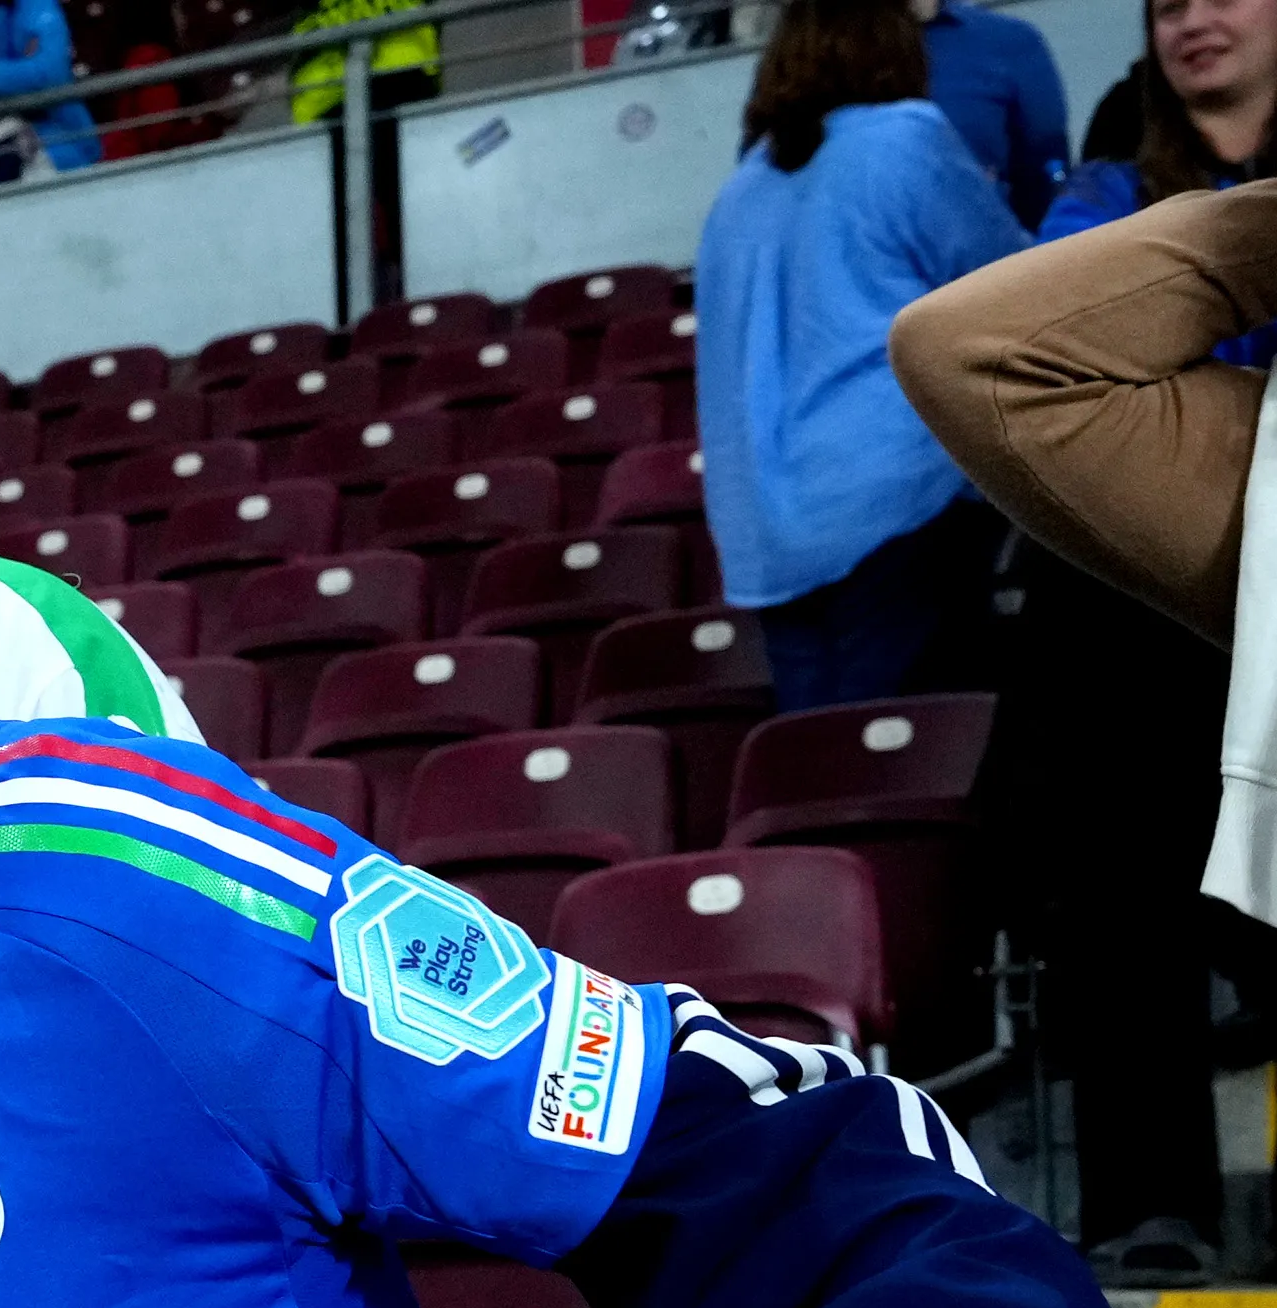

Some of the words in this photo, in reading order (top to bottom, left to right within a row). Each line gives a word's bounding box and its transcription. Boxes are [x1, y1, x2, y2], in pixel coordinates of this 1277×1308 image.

[397, 938, 428, 972] We
[424, 936, 460, 987] Play
[447, 924, 486, 996] Strong
[562, 966, 615, 1140] FOUNDATI
[537, 1070, 566, 1134] UEFA
